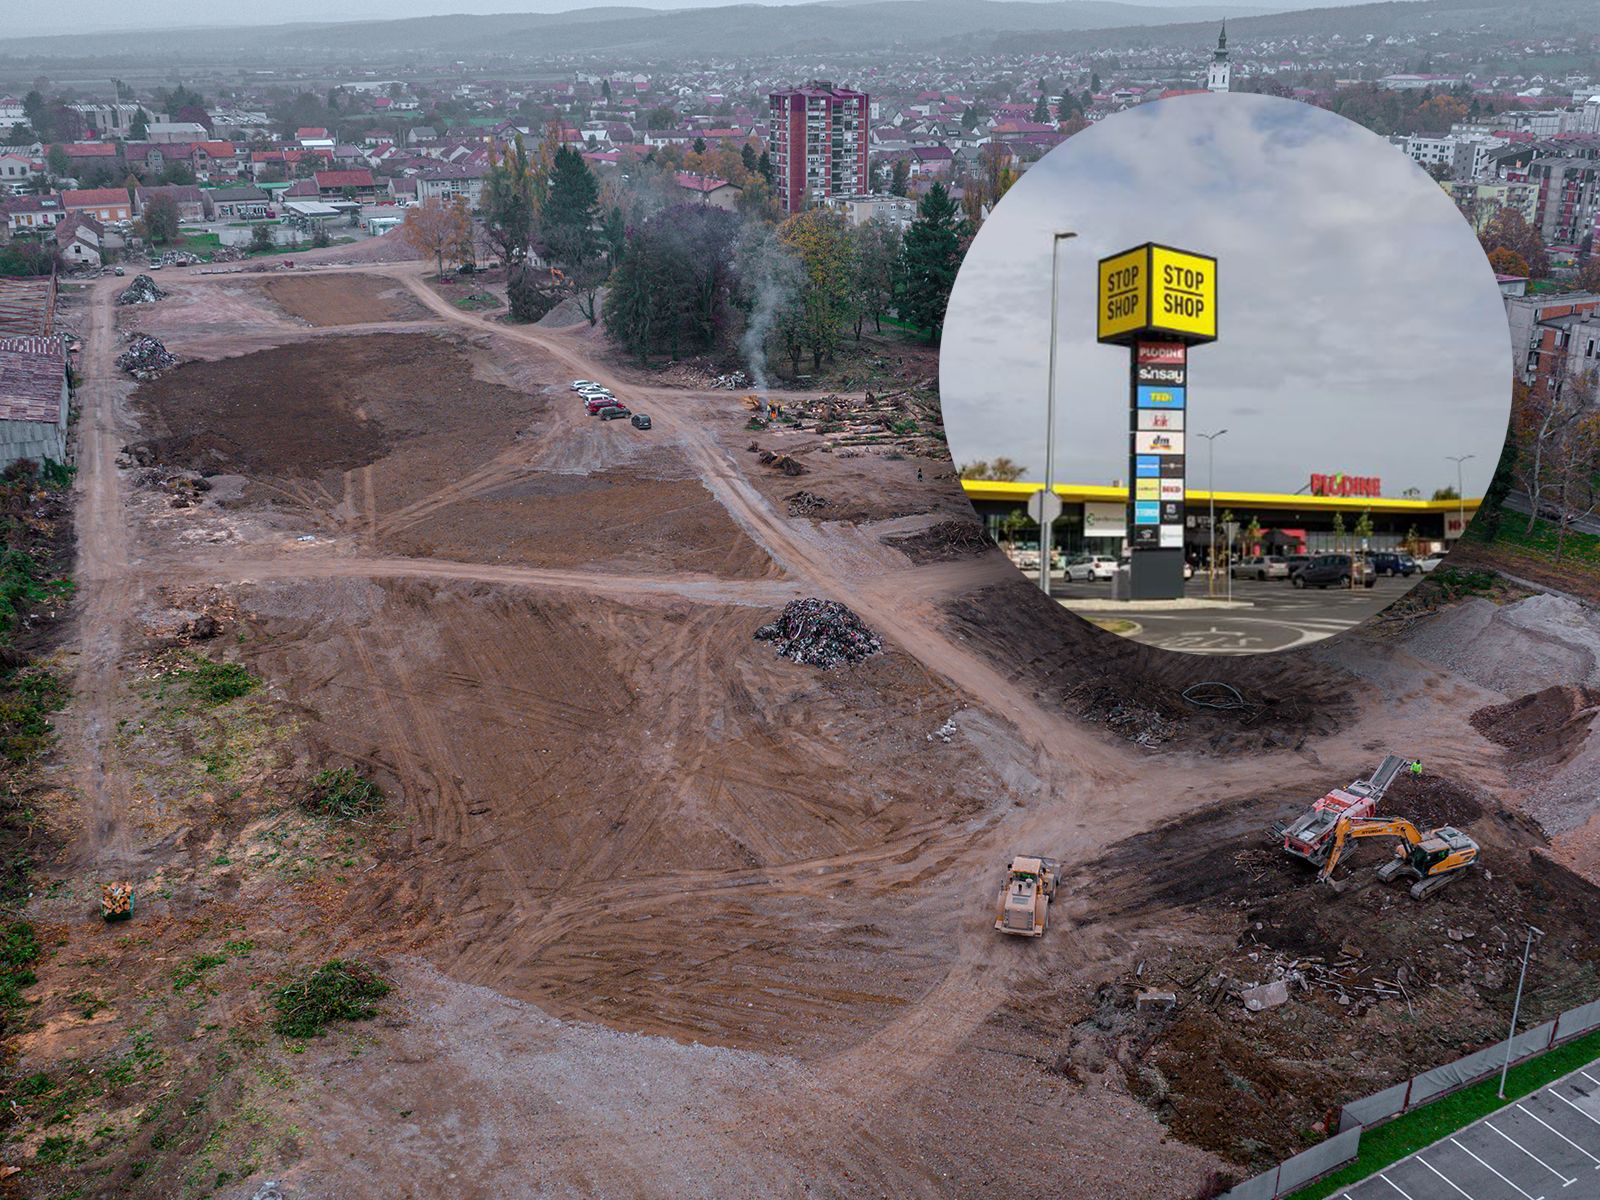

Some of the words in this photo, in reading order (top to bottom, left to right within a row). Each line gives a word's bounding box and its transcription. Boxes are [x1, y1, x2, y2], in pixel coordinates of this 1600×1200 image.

[1107, 265, 1139, 292] STOP
[1163, 264, 1204, 290] STOP
[1107, 294, 1139, 320] SHOP
[1163, 293, 1204, 318] SHOP
[1139, 366, 1184, 384] sinsay
[1311, 472, 1381, 497] PLODINE
